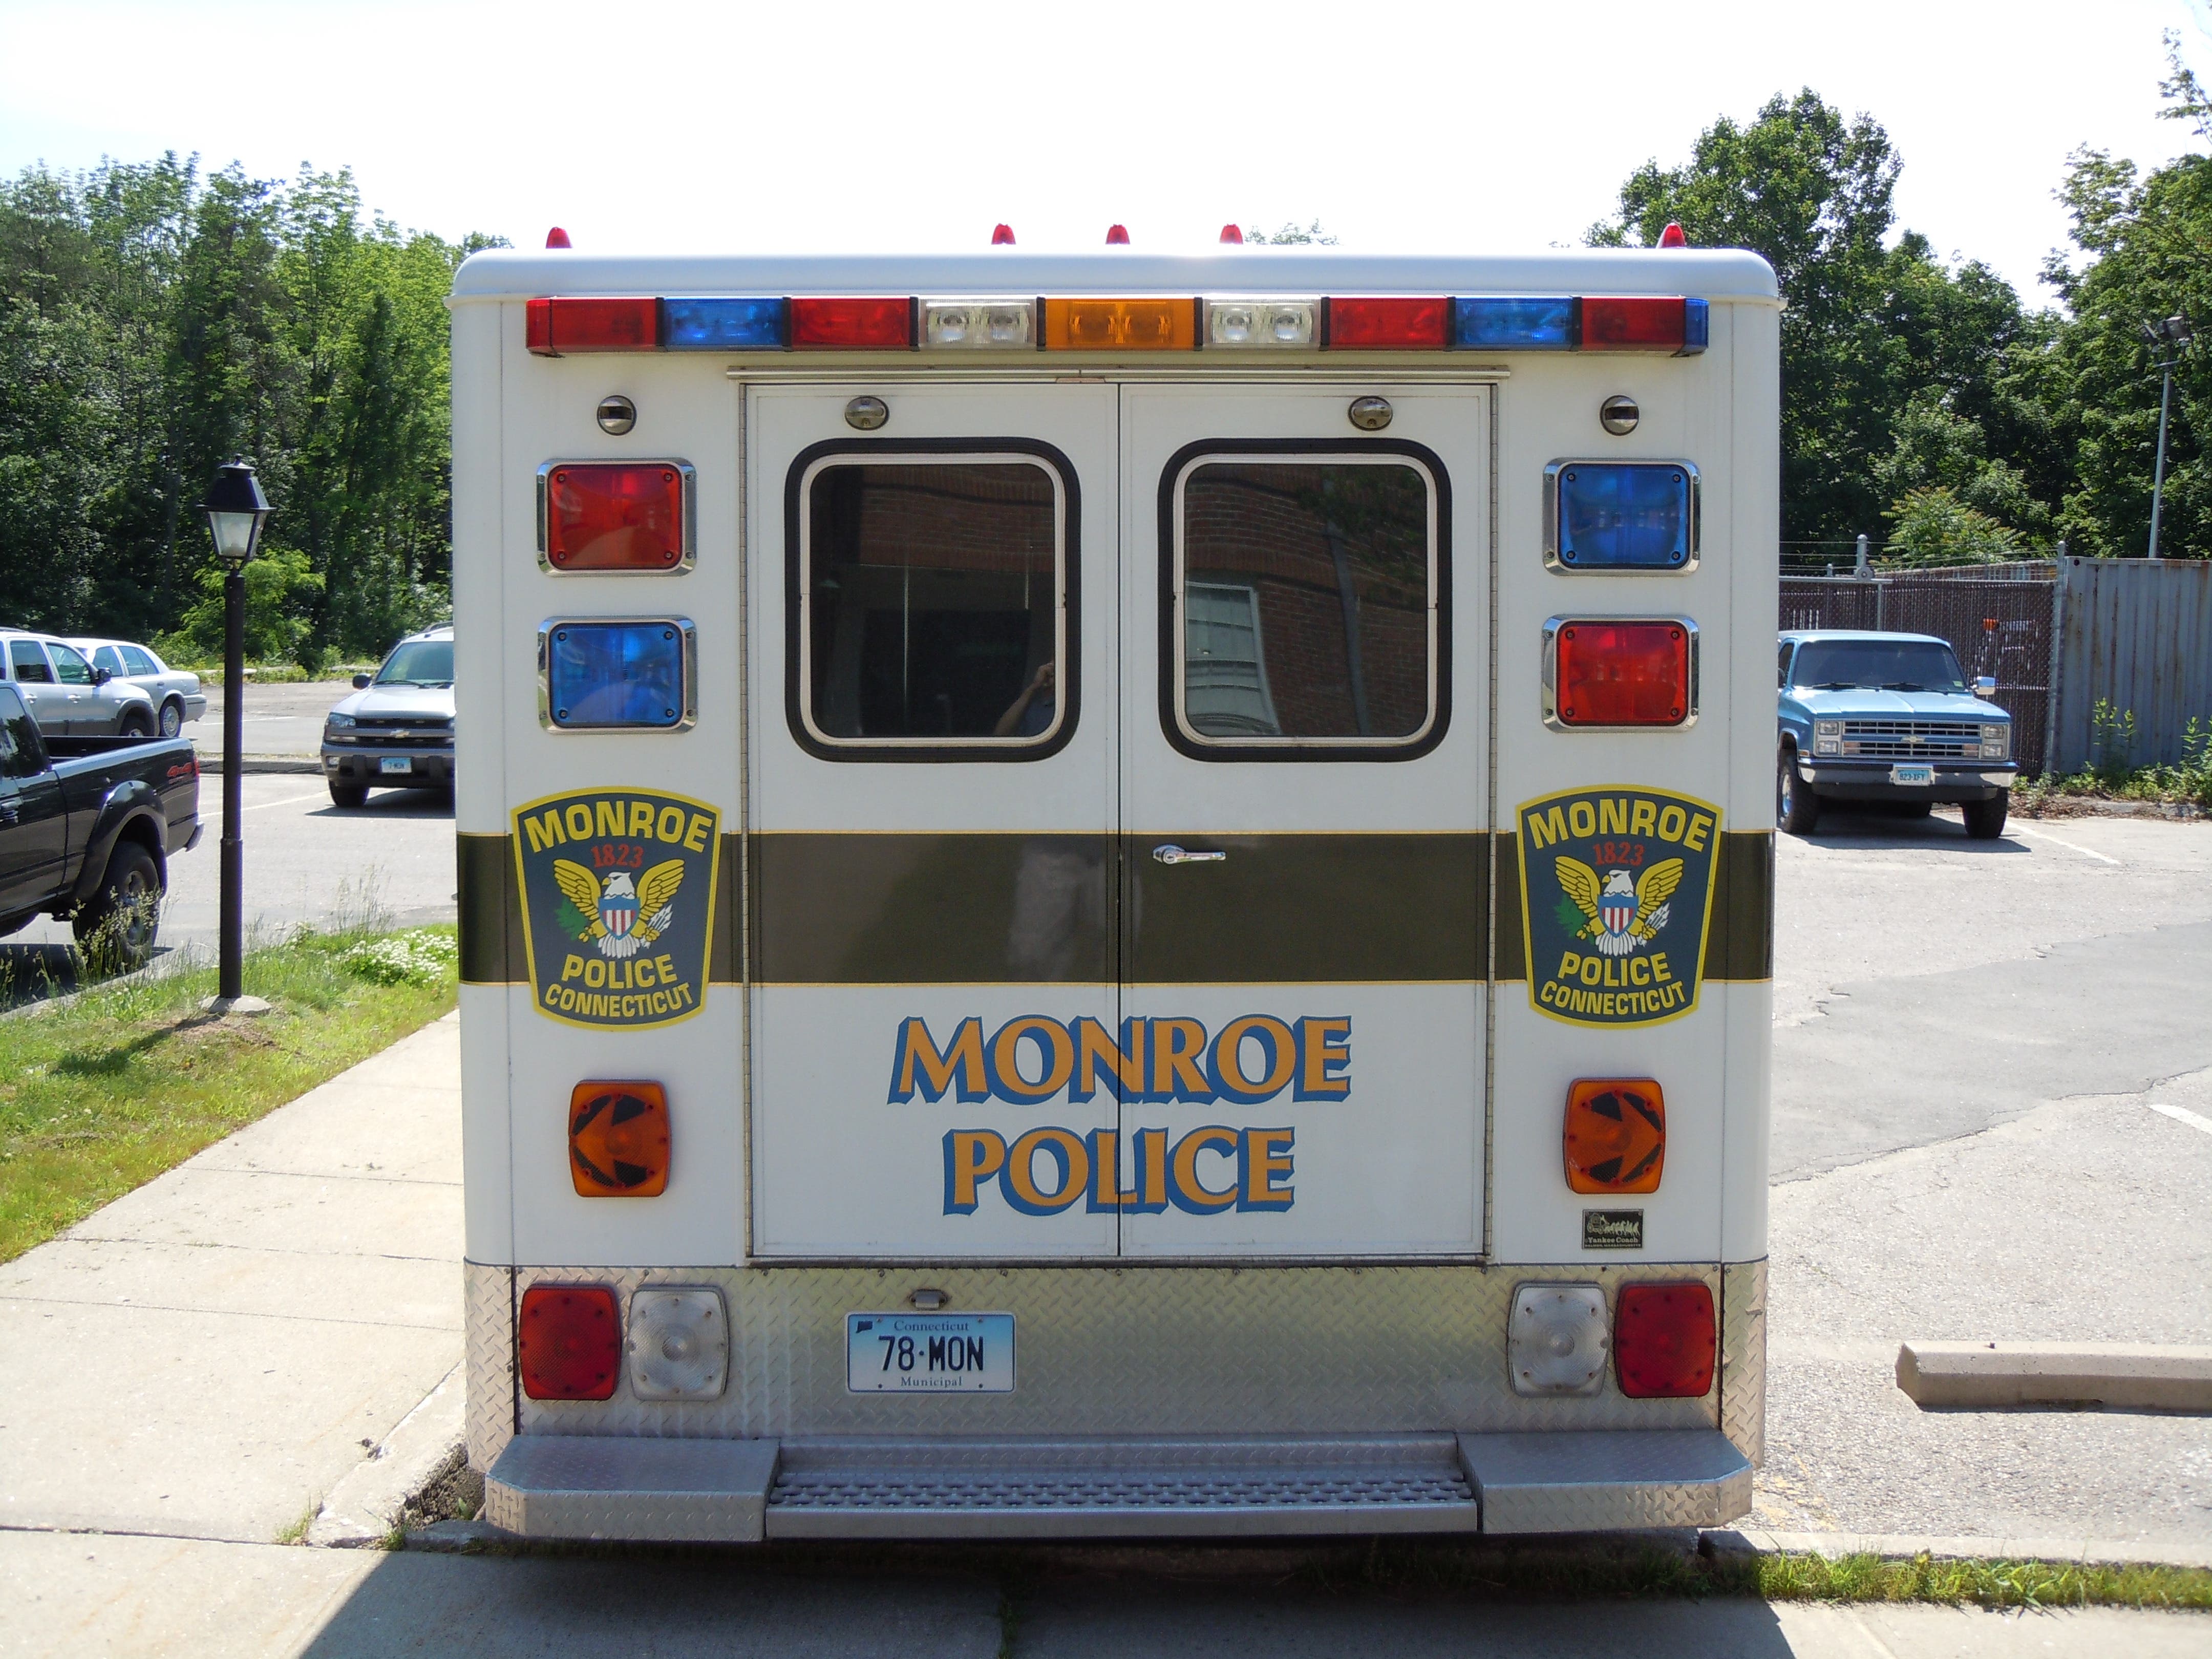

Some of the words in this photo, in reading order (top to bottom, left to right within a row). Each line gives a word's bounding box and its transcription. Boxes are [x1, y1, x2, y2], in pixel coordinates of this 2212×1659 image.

[523, 800, 713, 853] MONROE
[1527, 798, 1713, 853] MONROE
[590, 843, 644, 868] 1823
[1592, 841, 1645, 866] 1823
[561, 953, 678, 989] POLICE
[1557, 950, 1672, 987] POLICE
[544, 983, 693, 1018] CONNECTICUT
[1540, 980, 1687, 1015] CONNECTICUT
[886, 1013, 1352, 1105] MONROE
[942, 1124, 1295, 1216] POLICE
[894, 1320, 969, 1332] Connecticut
[900, 1376, 963, 1388] Municipal
